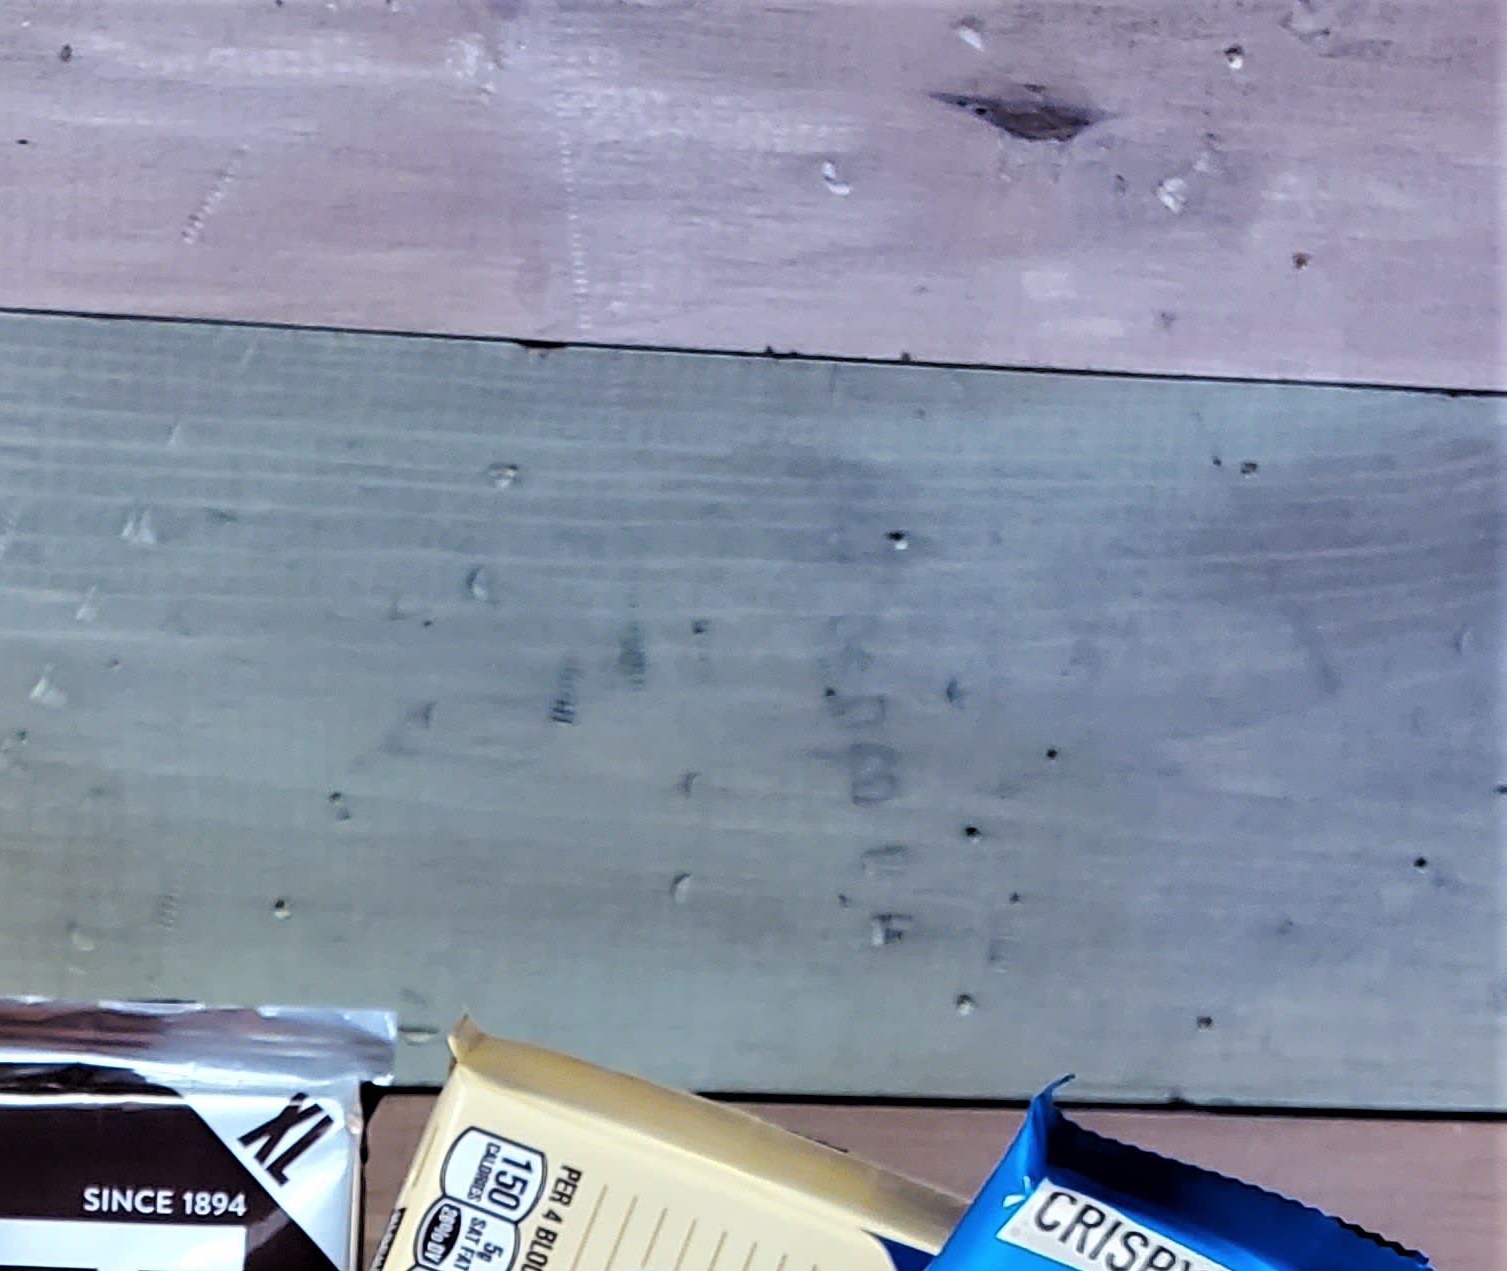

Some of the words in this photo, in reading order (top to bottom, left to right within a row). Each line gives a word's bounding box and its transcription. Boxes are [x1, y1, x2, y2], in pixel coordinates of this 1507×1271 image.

[237, 1092, 334, 1187] XL
[467, 1141, 501, 1203] CALORIES
[487, 1157, 534, 1212] 150
[548, 1164, 583, 1207] PER
[83, 1187, 175, 1216] SINCE
[182, 1191, 248, 1218] 1894
[542, 1209, 563, 1226] 4
[463, 1216, 487, 1246] SAT
[476, 1242, 504, 1263] 5g
